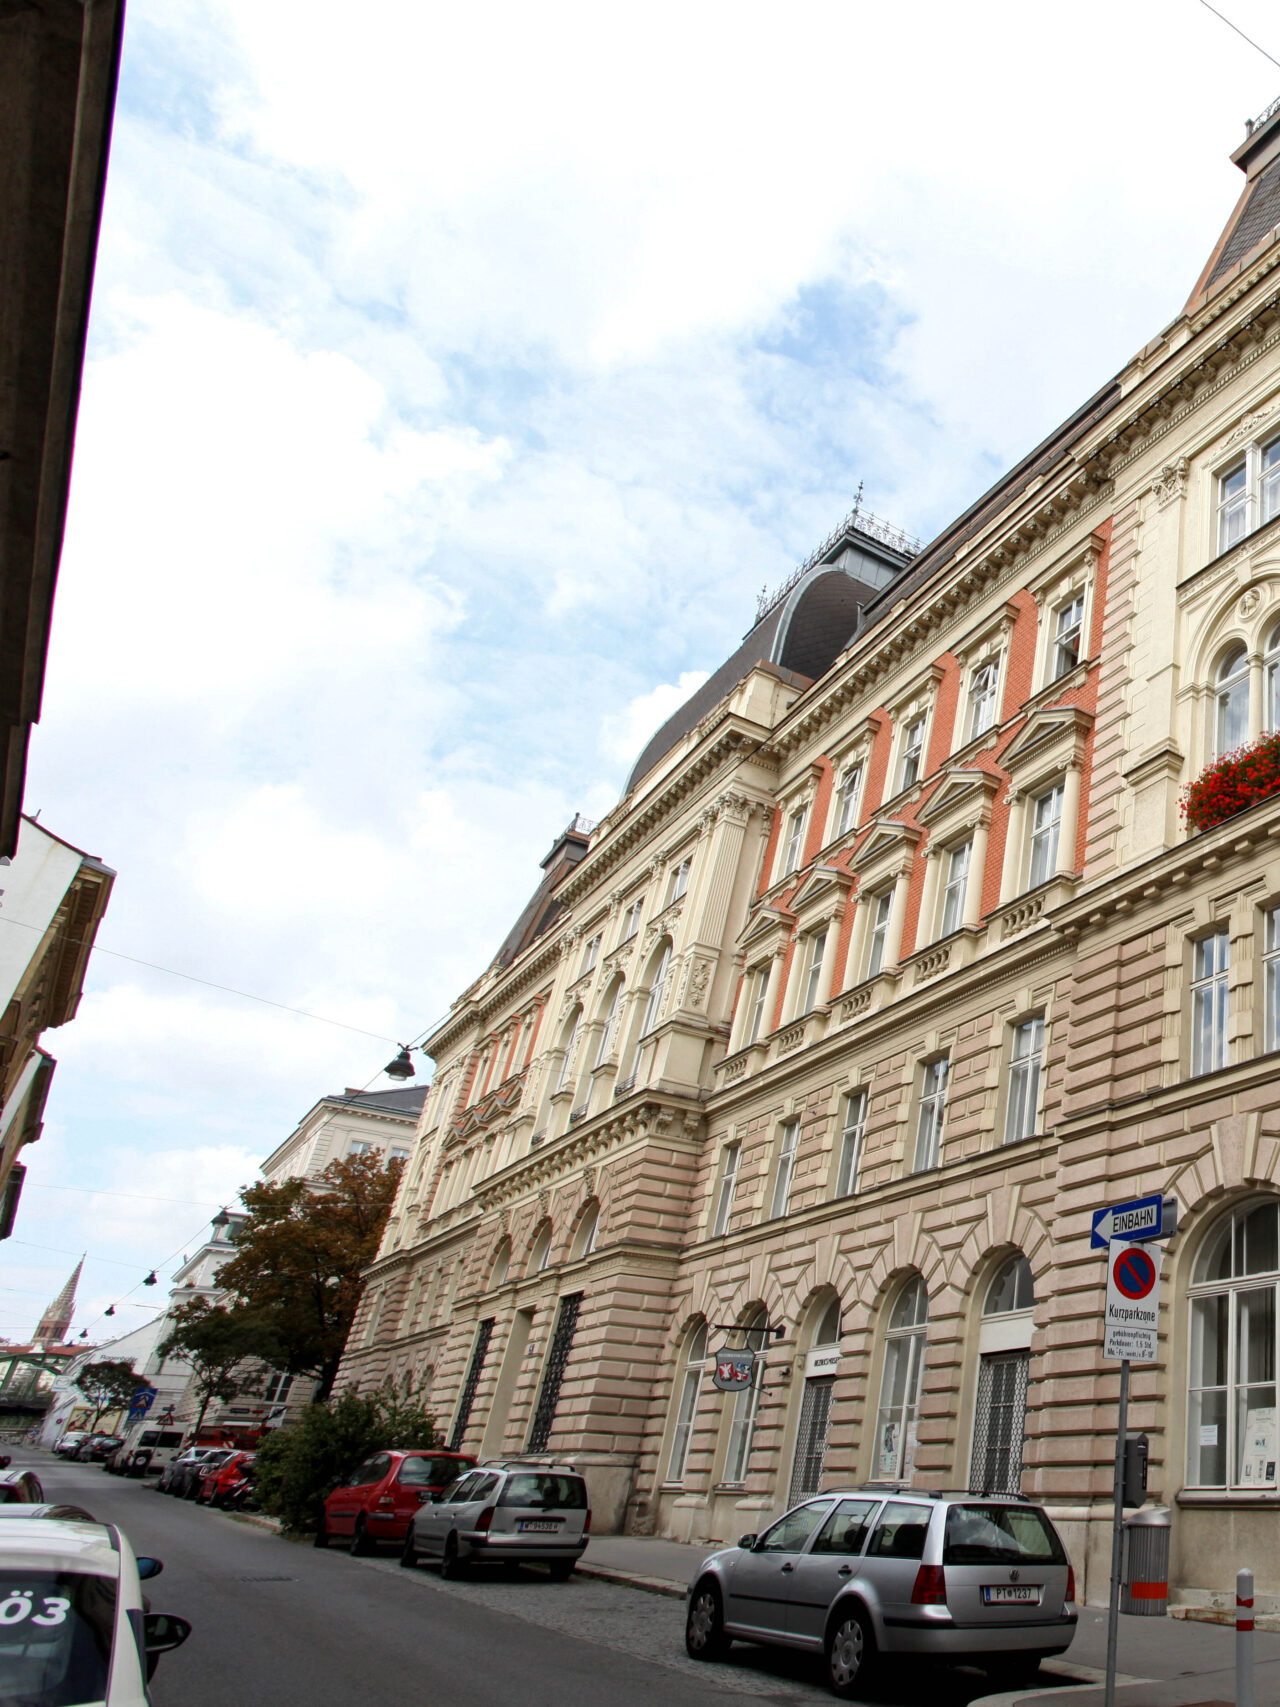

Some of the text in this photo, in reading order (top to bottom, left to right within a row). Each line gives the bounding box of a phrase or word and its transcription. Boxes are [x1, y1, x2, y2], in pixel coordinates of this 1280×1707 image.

[1112, 1207, 1154, 1233] EINBAHN
[1109, 1303, 1156, 1322] Kurzparkzone
[1013, 1587, 1031, 1599] 1237
[0, 1590, 71, 1626] Ö3
